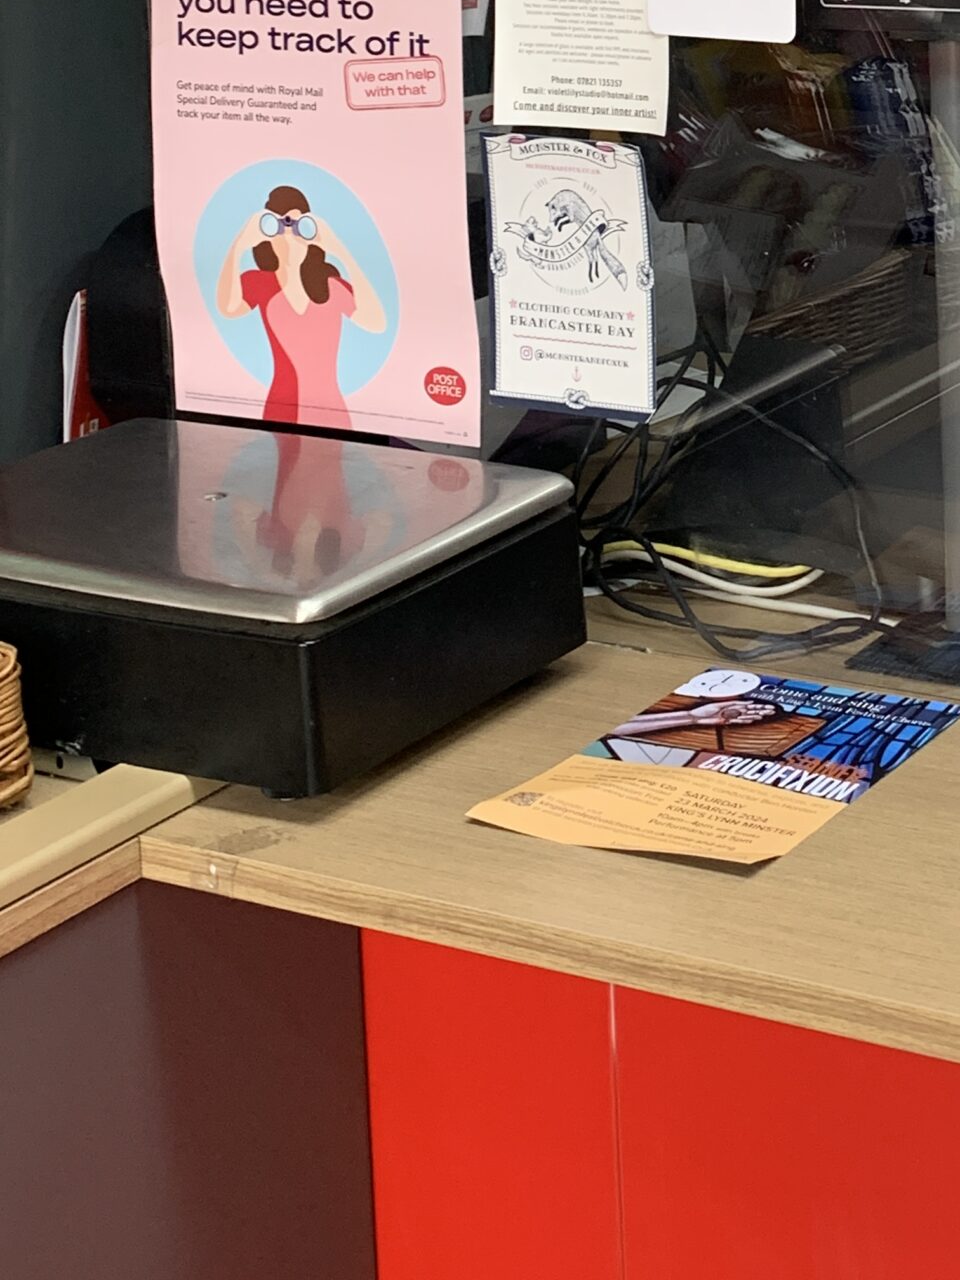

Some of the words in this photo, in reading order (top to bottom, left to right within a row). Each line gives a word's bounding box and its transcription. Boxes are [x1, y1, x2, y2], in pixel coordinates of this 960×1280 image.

[177, 22, 259, 54] keep
[268, 28, 357, 54] track
[365, 31, 400, 56] of
[408, 32, 430, 57] it
[353, 70, 376, 83] We
[378, 71, 404, 82] can
[405, 68, 436, 84] help
[551, 75, 575, 86] Phone:
[176, 80, 192, 91] Get
[194, 83, 219, 94] peace
[221, 82, 231, 92] of
[232, 83, 255, 94] mind
[257, 84, 276, 95] with
[278, 85, 303, 98] Royal
[305, 87, 324, 97] Mail
[365, 86, 395, 98] with
[398, 84, 427, 97] that
[523, 86, 546, 96] Email:
[176, 94, 208, 107] Special
[209, 96, 246, 108] Delivery
[247, 98, 298, 110] Guaranteed
[300, 101, 317, 111] and
[513, 101, 537, 111] Come
[540, 102, 555, 113] and
[557, 103, 590, 115] discover
[591, 106, 610, 117] your
[611, 106, 632, 117] inner
[634, 107, 657, 120] artist!
[177, 109, 198, 119] track
[200, 110, 220, 122] your
[222, 111, 242, 121] item
[243, 112, 254, 122] all
[255, 112, 270, 123] the
[271, 115, 293, 126] way.
[519, 142, 571, 155] MONSTER
[586, 148, 608, 163] FOX
[519, 302, 571, 315] CLOTHING
[573, 307, 625, 320] COMPANY
[510, 315, 602, 335] BRANCASTER
[607, 325, 636, 338] BAY
[433, 374, 459, 387] POST
[427, 385, 462, 398] OFFICE
[750, 692, 774, 701] with
[811, 702, 843, 714] Lynn
[845, 707, 889, 722] Festival
[759, 683, 808, 699] Come
[811, 693, 848, 705] and
[848, 698, 887, 713] sing
[698, 754, 861, 802] CRUCIFIXION
[674, 798, 690, 807] 23
[693, 801, 736, 818] MARCH
[683, 790, 748, 810] SATURDAY
[666, 805, 706, 819] KING'S
[708, 814, 741, 826] LYNN
[742, 821, 798, 837] MINSTER
